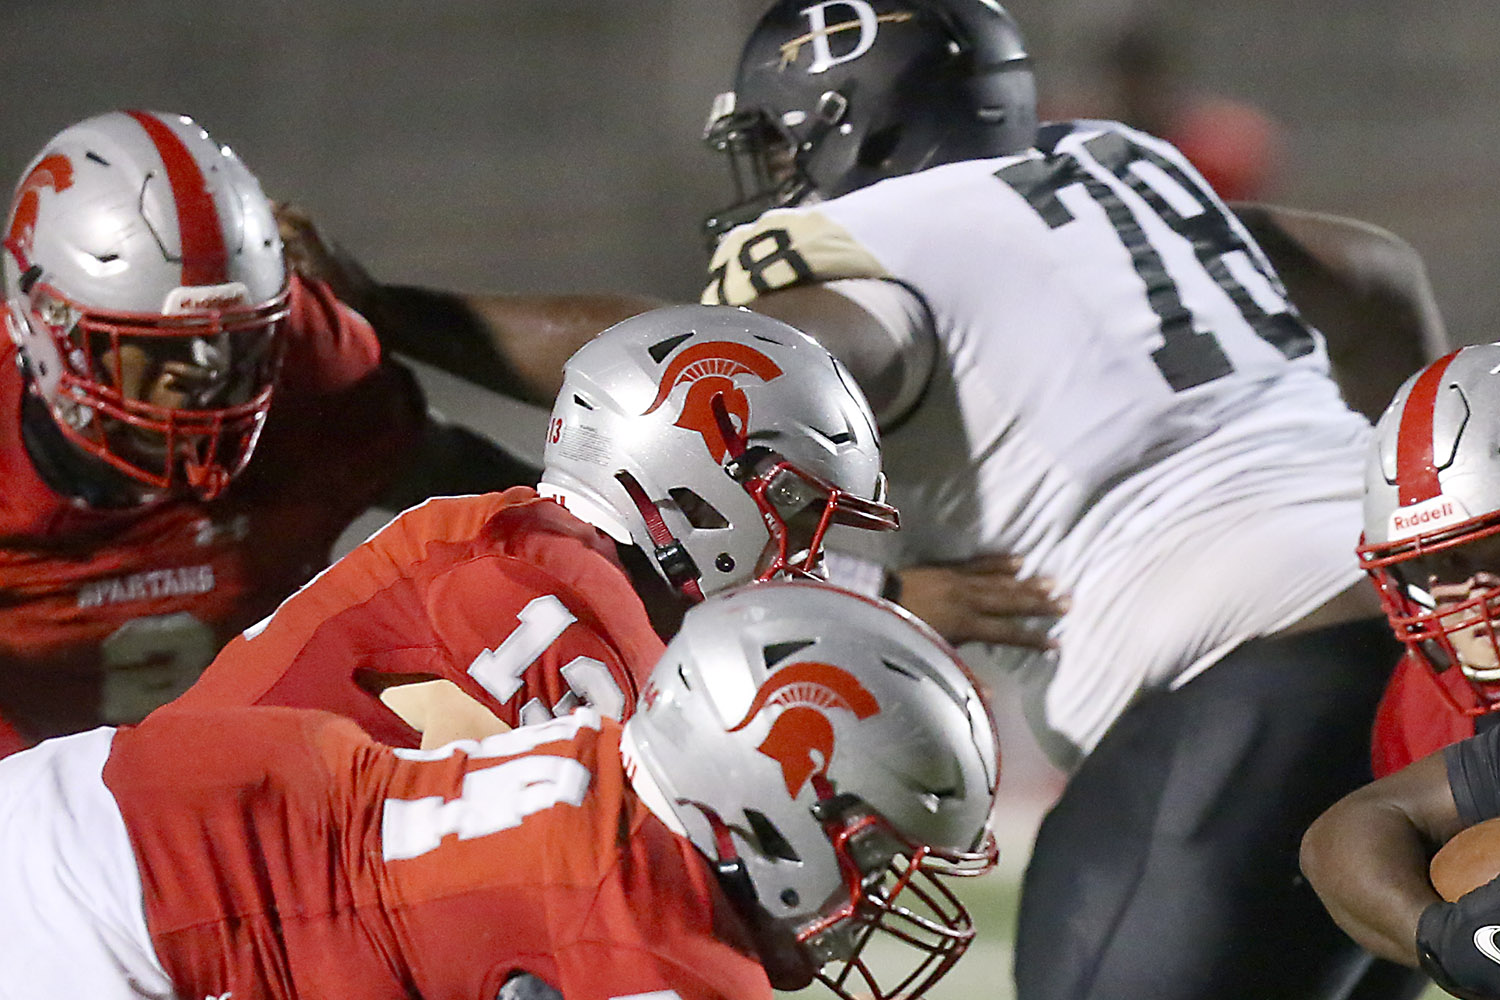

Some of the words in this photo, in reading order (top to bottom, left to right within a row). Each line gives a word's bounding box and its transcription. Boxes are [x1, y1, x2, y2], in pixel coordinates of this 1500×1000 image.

[800, 0, 878, 74] D
[992, 130, 1316, 394] 78
[1393, 502, 1454, 531] Riddell
